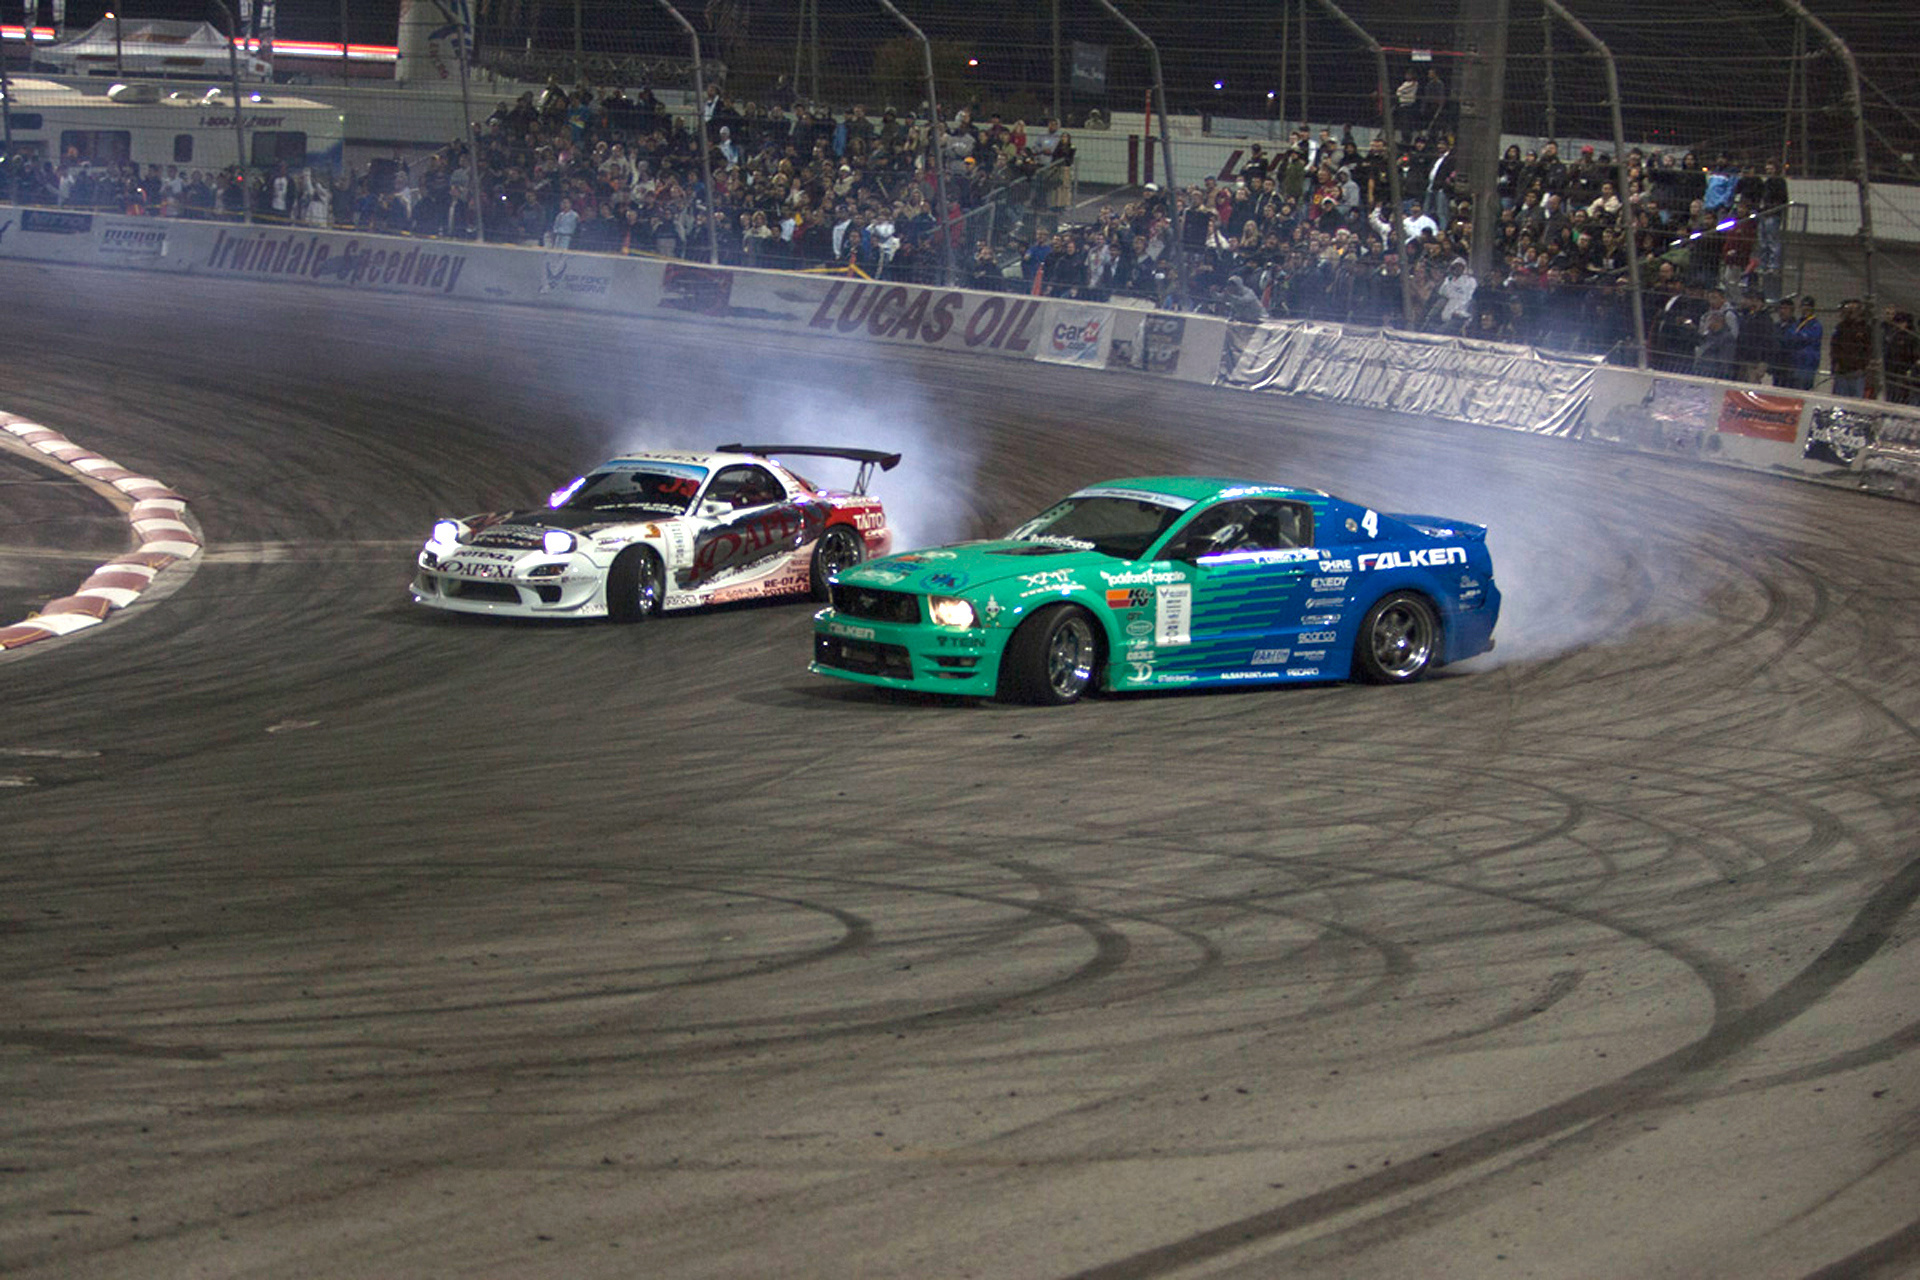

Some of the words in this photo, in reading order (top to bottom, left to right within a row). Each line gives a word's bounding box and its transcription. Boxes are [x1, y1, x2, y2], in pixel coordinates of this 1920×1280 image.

[207, 229, 331, 279] Irwindale
[337, 240, 466, 293] Speedway
[808, 281, 964, 343] LUCAS
[964, 297, 1042, 351] OIL
[1361, 509, 1378, 538] 4
[454, 550, 514, 562] POTENZA
[1357, 547, 1467, 572] FALKEN
[1311, 576, 1349, 588] EXEDY
